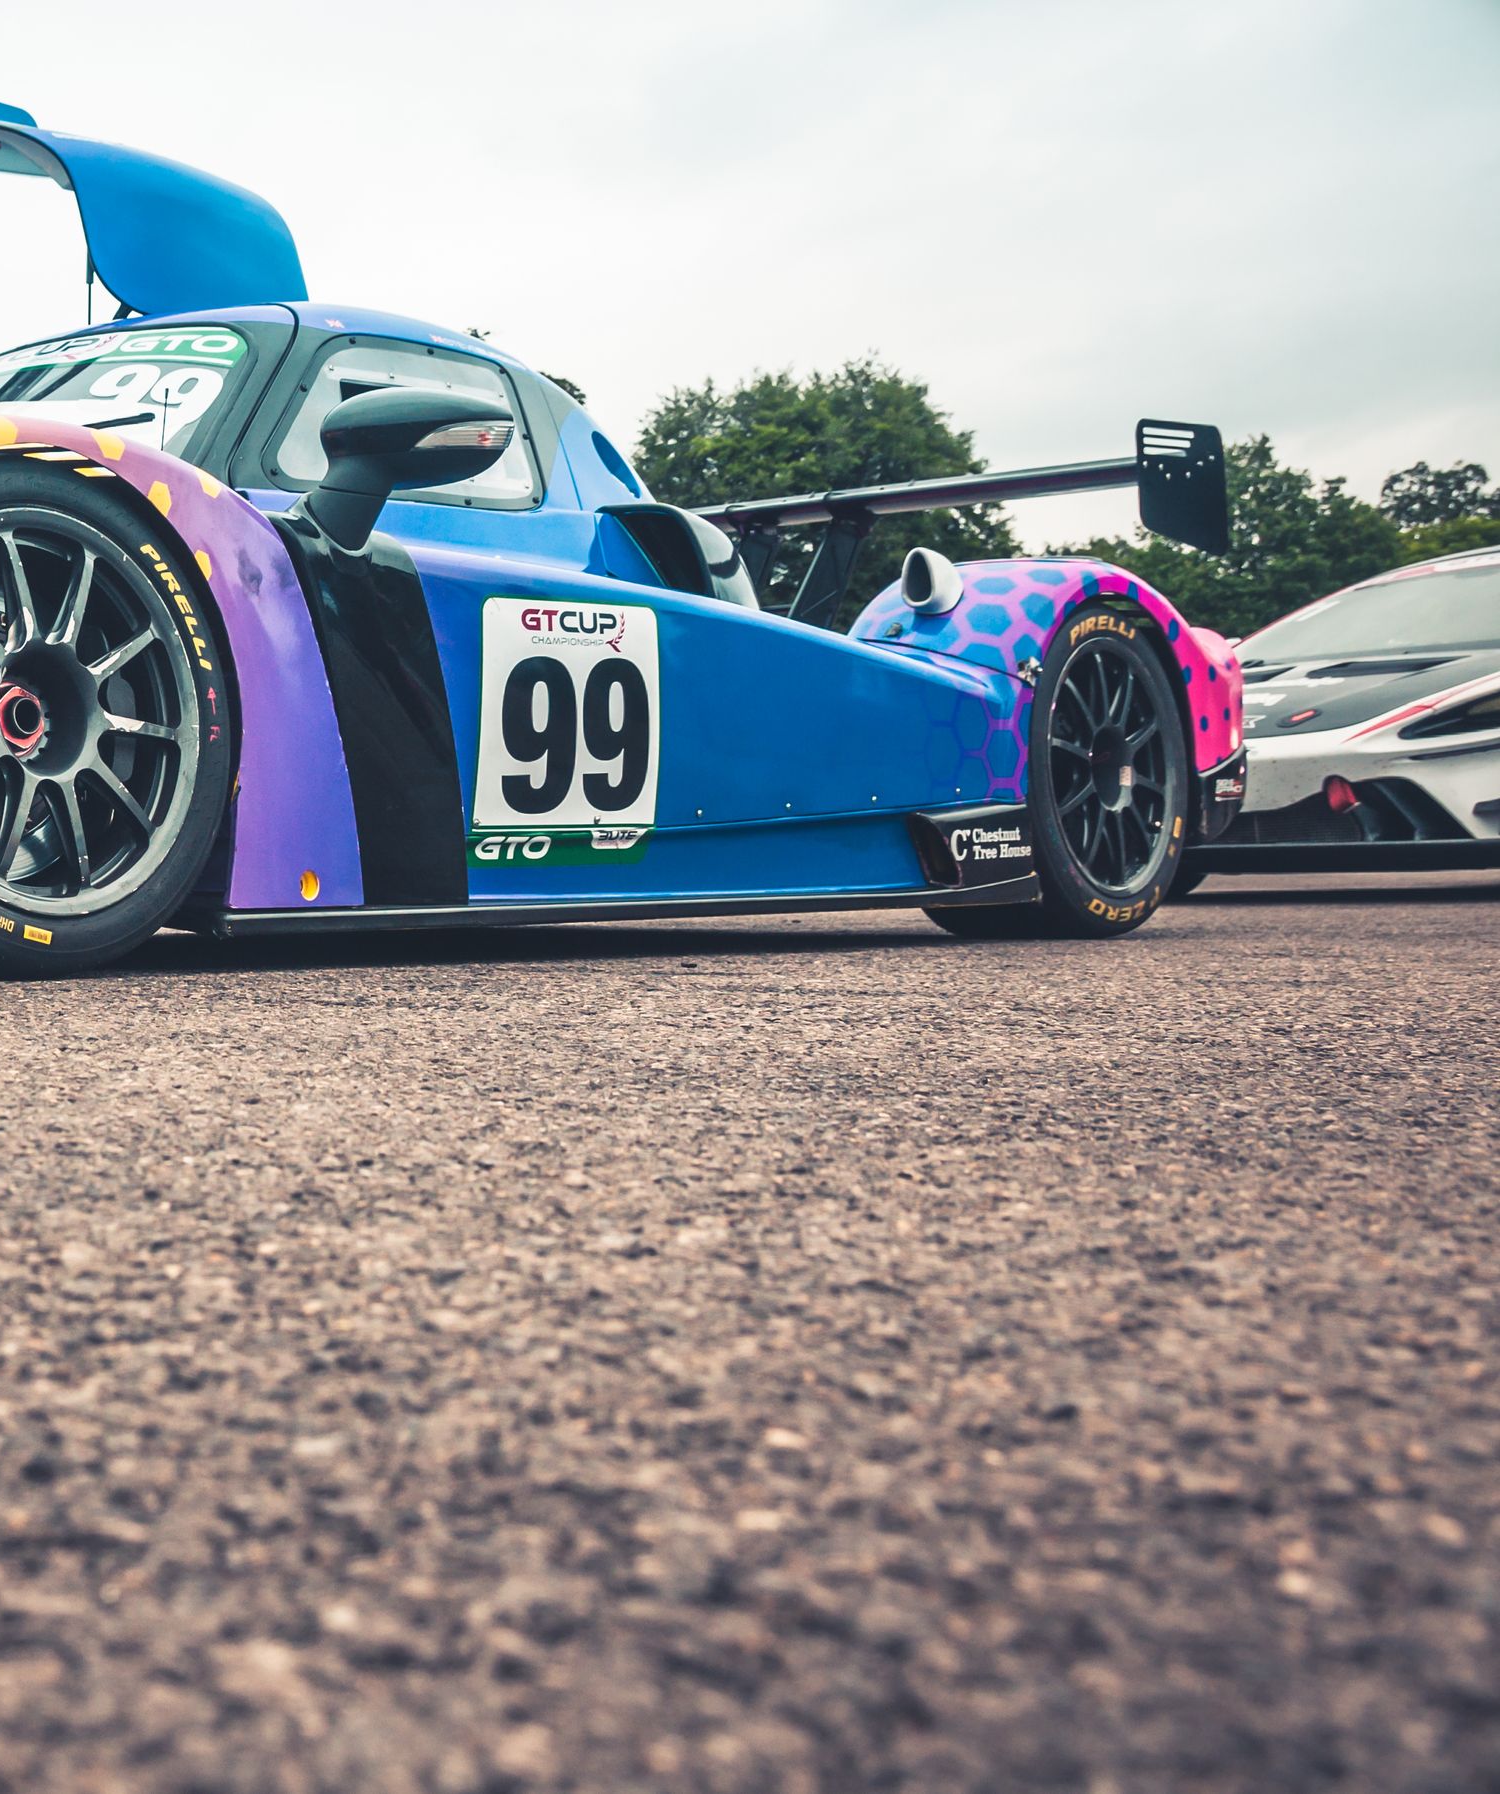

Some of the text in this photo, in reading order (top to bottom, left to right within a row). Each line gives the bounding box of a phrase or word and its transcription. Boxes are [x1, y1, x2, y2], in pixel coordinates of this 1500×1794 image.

[119, 334, 238, 353] GTO
[88, 364, 224, 427] 99
[140, 543, 212, 671] PIRELLI
[531, 635, 605, 647] CHAMPIONSHIP
[1069, 615, 1136, 646] PIRELLI
[501, 655, 650, 814] 99
[972, 826, 1021, 843] Chestnut
[474, 836, 551, 860] GTO
[972, 843, 1032, 860] Tree House
[1087, 898, 1146, 921] ZERO
